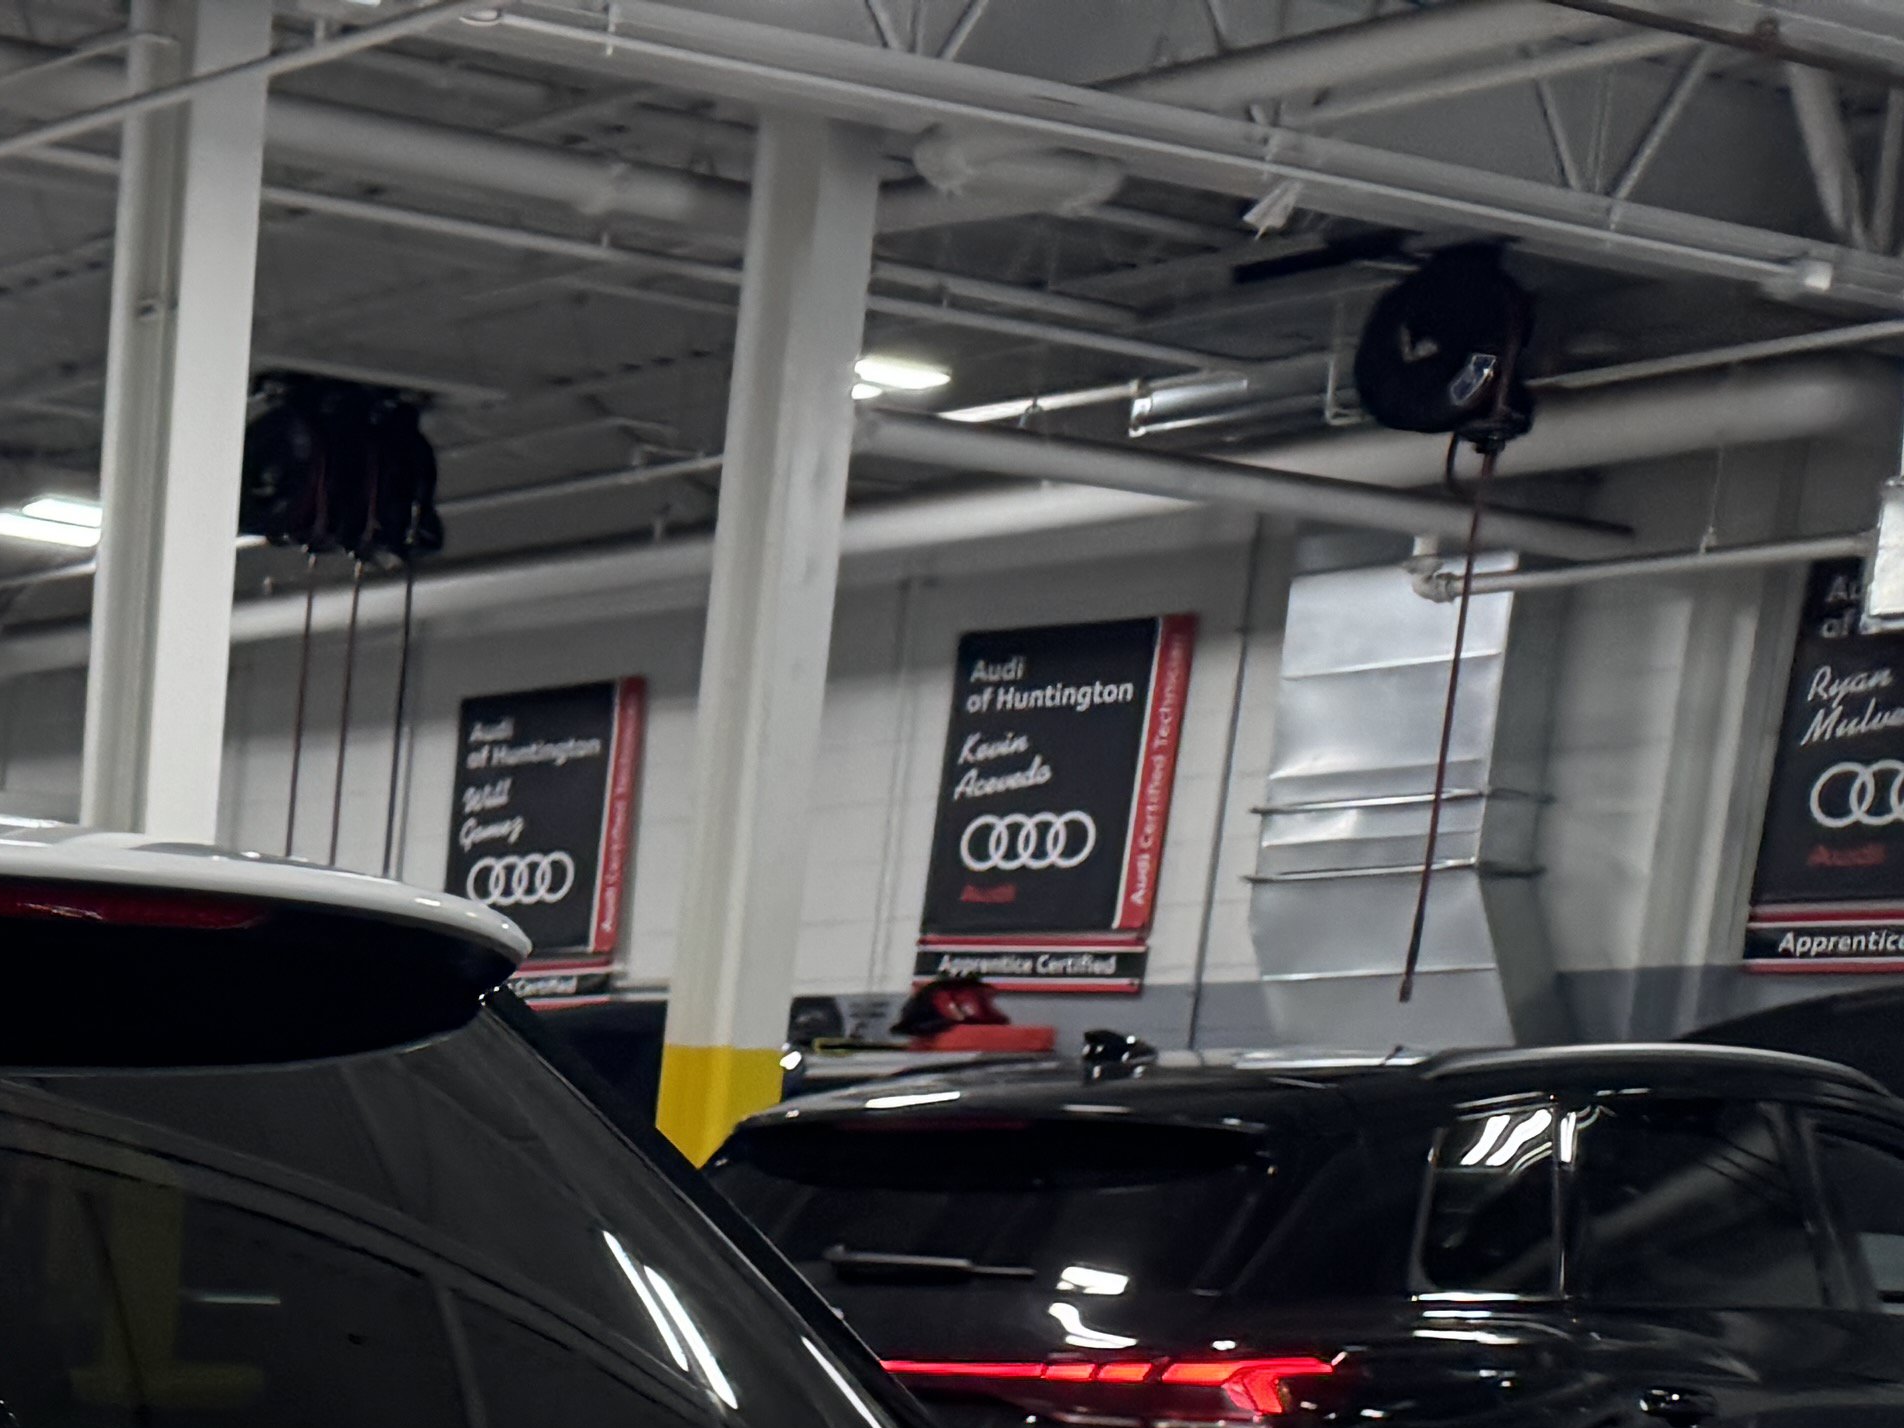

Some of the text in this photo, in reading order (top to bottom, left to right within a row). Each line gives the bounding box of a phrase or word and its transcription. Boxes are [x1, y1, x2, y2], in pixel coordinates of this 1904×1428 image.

[970, 657, 1026, 682] Audi
[965, 680, 1134, 714] of Huntington
[1807, 665, 1892, 709] Ryan
[491, 737, 601, 767] Huntington
[957, 731, 1029, 764] Kevin
[1130, 853, 1152, 905] Audi
[1035, 953, 1117, 976] Certified
